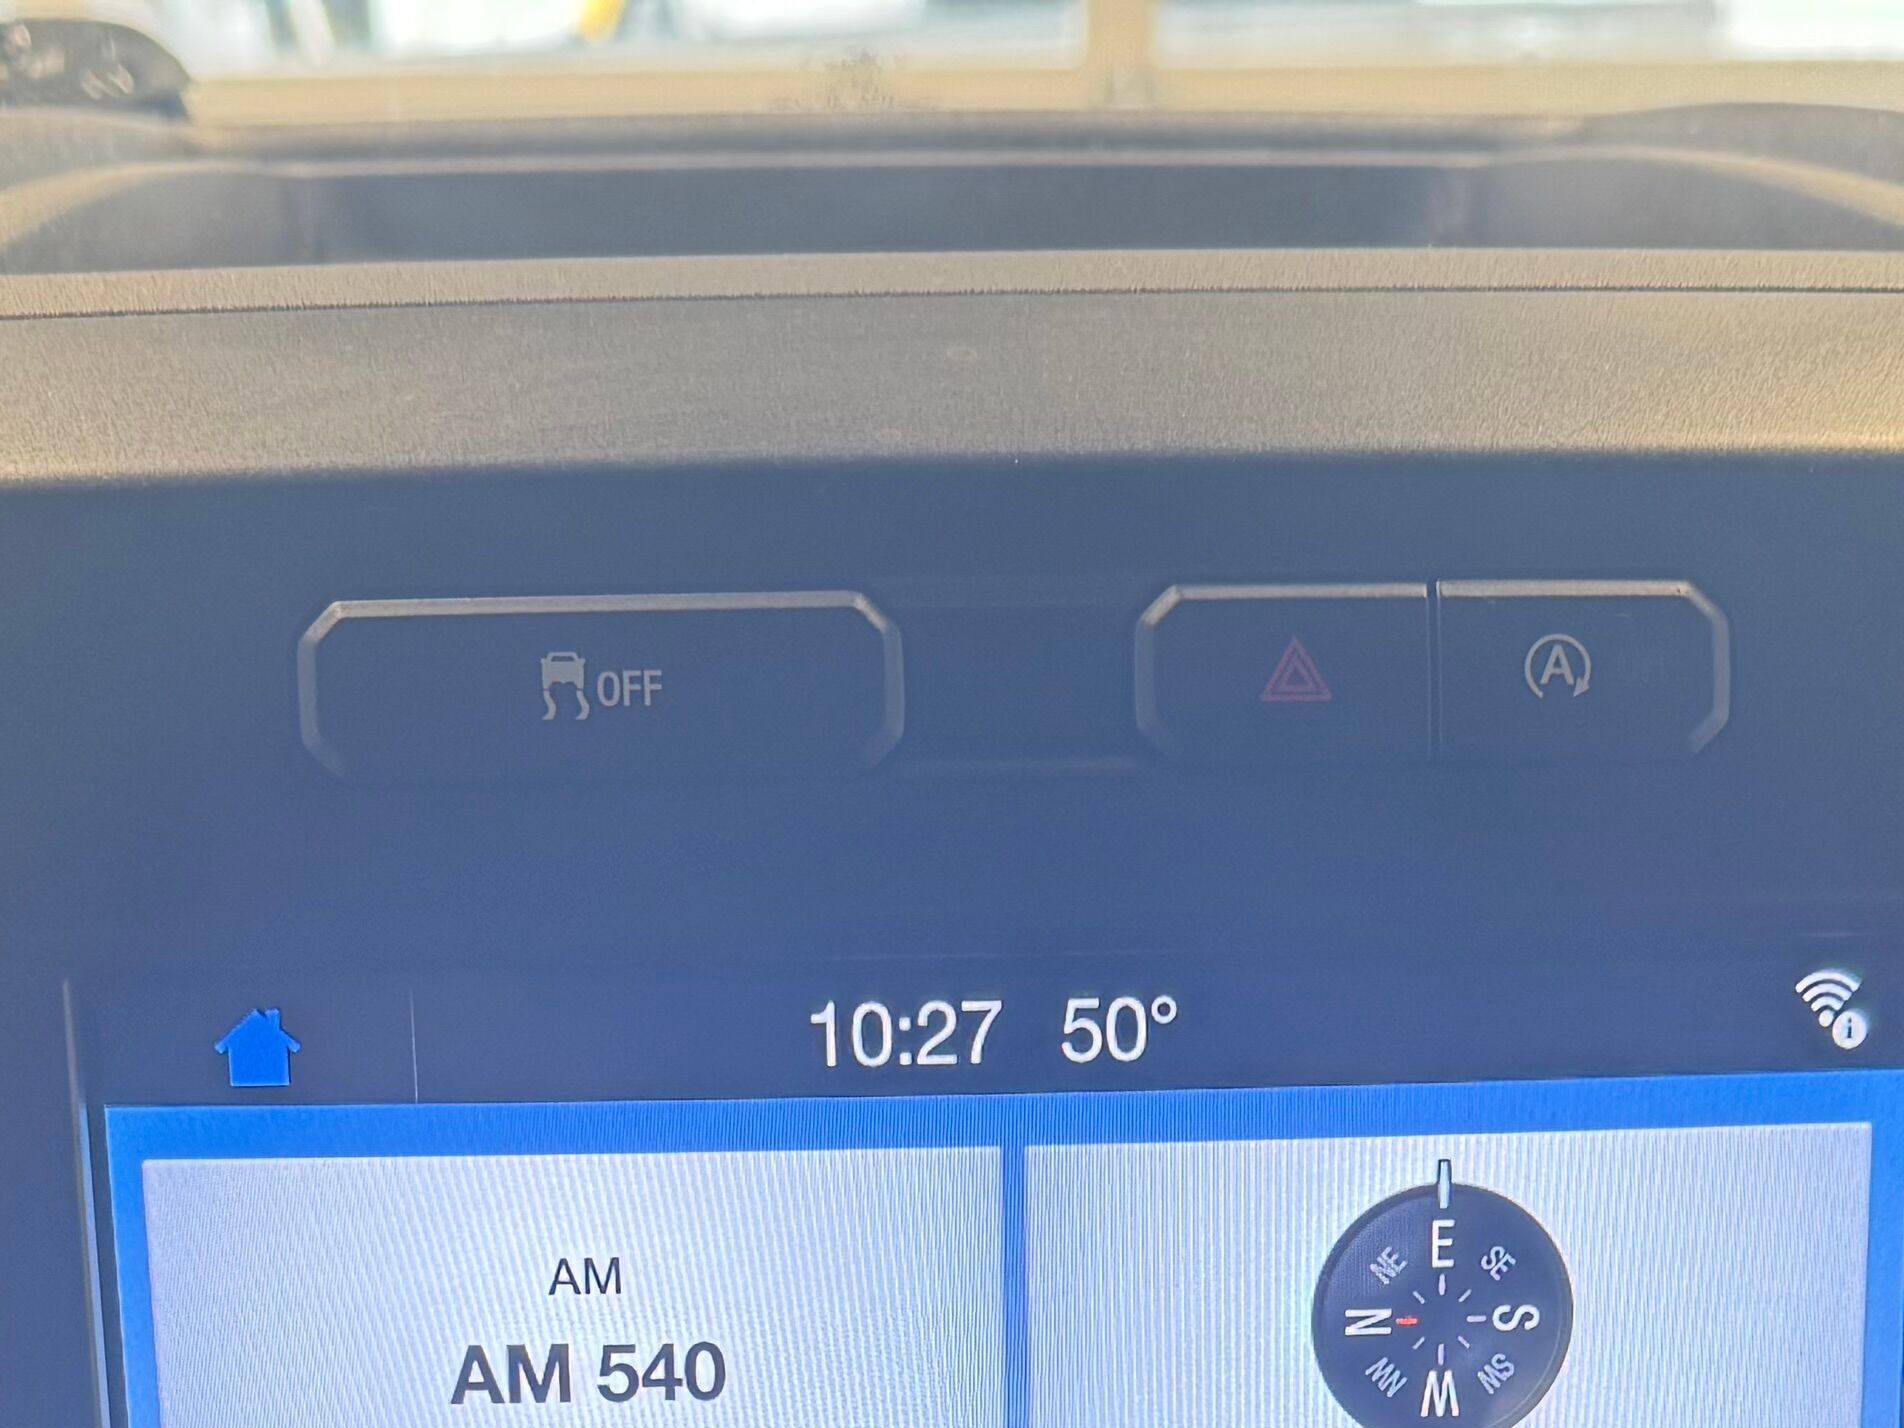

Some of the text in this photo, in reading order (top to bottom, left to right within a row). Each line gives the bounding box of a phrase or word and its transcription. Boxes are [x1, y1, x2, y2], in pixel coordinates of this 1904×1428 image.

[597, 667, 664, 707] OFF
[810, 994, 1179, 1068] 10:27 50°
[1430, 1219, 1456, 1269] E
[1480, 1245, 1517, 1281] SE
[549, 1256, 622, 1296] AM
[1368, 1246, 1409, 1285] NE
[1344, 1307, 1393, 1337] N
[1491, 1303, 1541, 1332] S
[450, 1341, 727, 1405] AM 540
[1364, 1356, 1408, 1398] NW
[1420, 1369, 1460, 1418] W
[1477, 1352, 1516, 1395] SW
